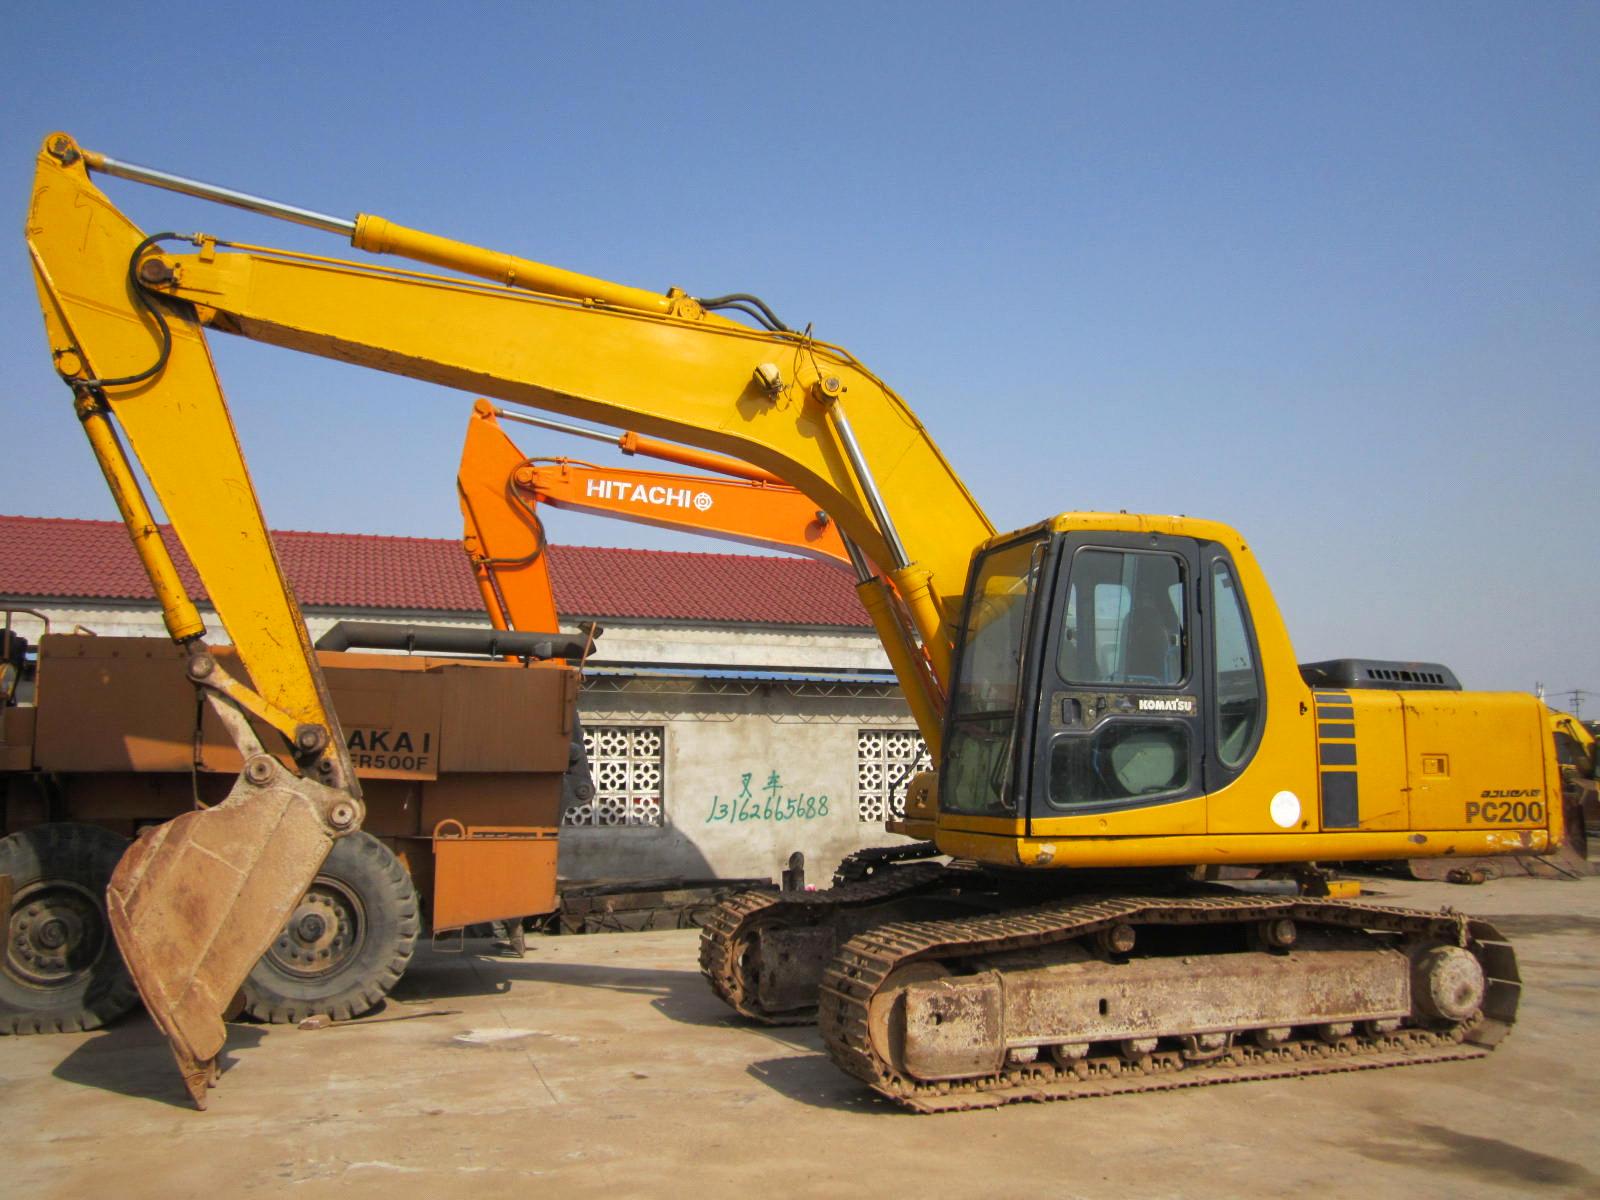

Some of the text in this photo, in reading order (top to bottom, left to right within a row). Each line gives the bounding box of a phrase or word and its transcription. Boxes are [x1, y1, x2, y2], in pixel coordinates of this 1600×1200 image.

[586, 479, 692, 508] HITACHI
[1138, 698, 1192, 711] KOMATSU
[705, 792, 829, 824] 13162665688
[1465, 801, 1543, 823] PC200
